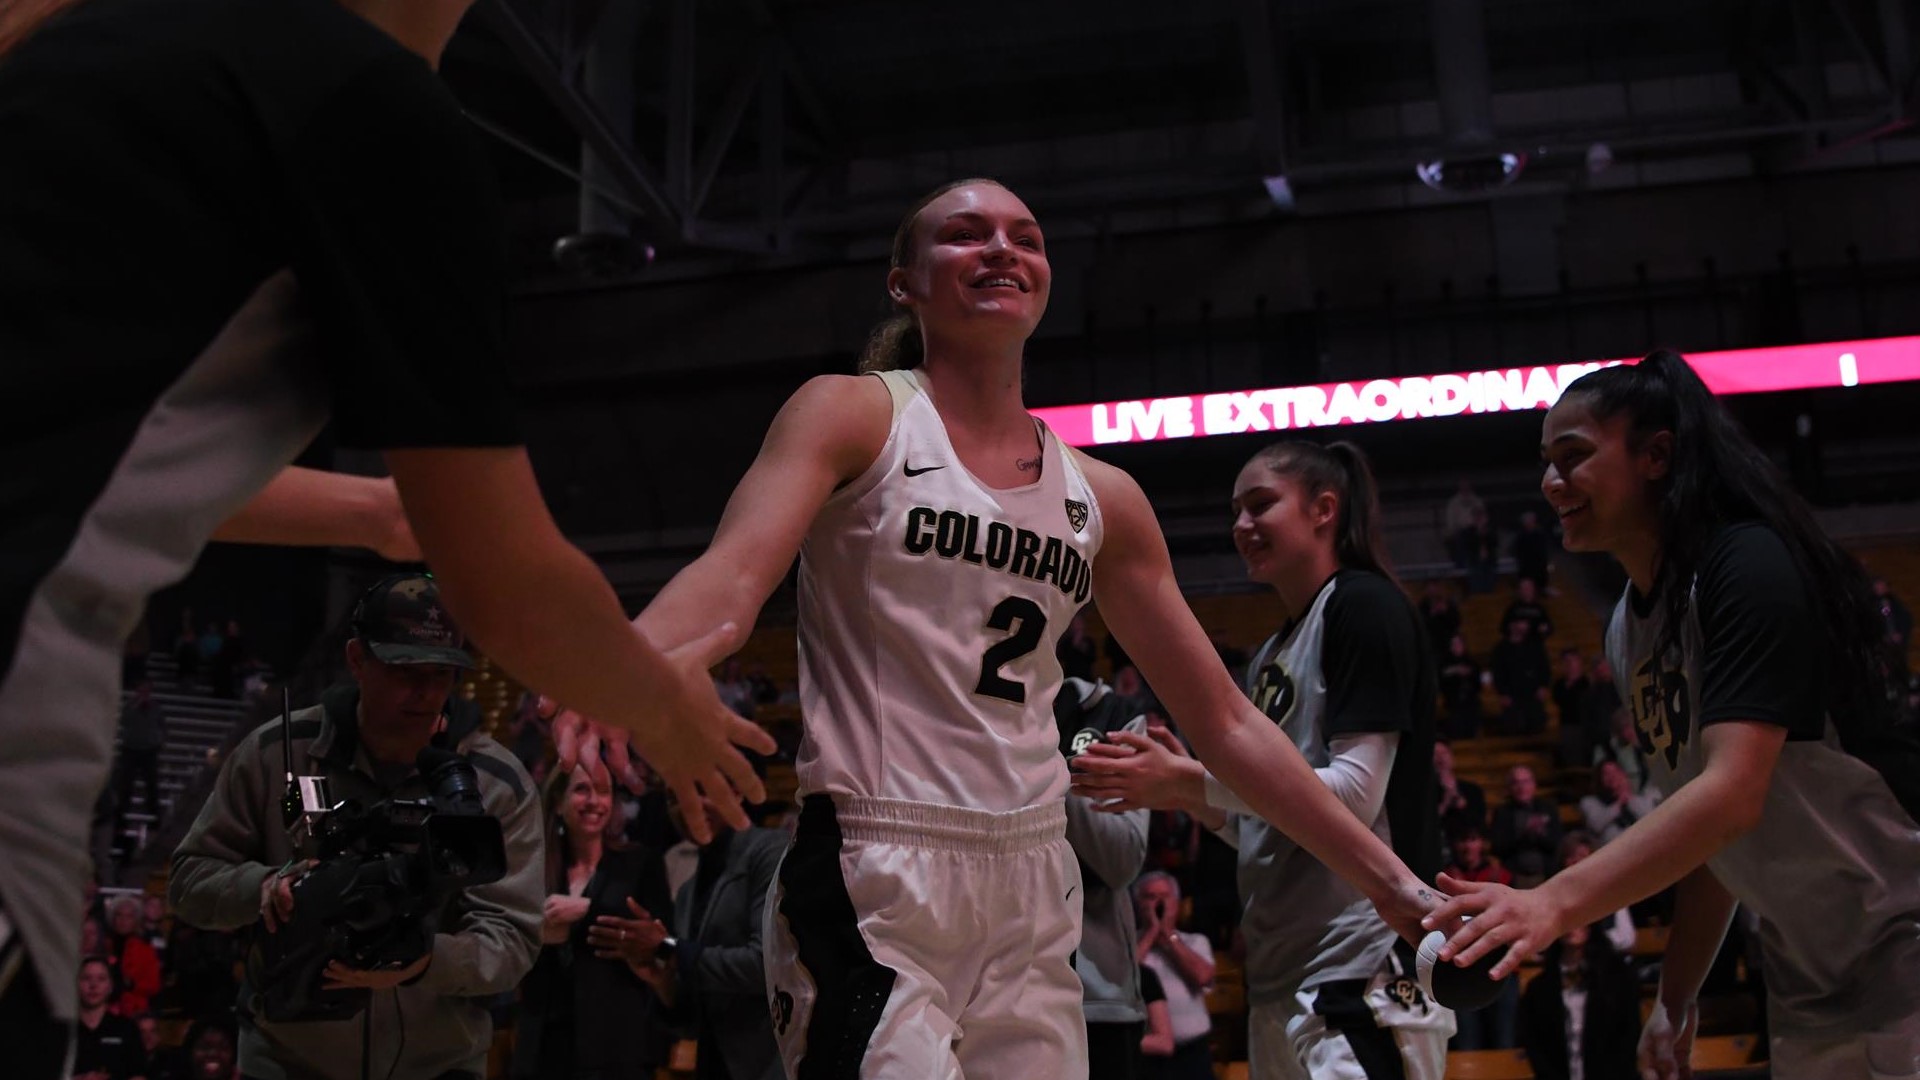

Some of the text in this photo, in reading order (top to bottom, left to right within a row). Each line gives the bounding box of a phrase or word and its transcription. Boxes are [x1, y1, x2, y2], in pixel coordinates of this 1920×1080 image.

[1092, 361, 1622, 444] LIVE EXTRAORDINA
[905, 507, 1090, 603] COLORADO
[975, 596, 1047, 703] 2
